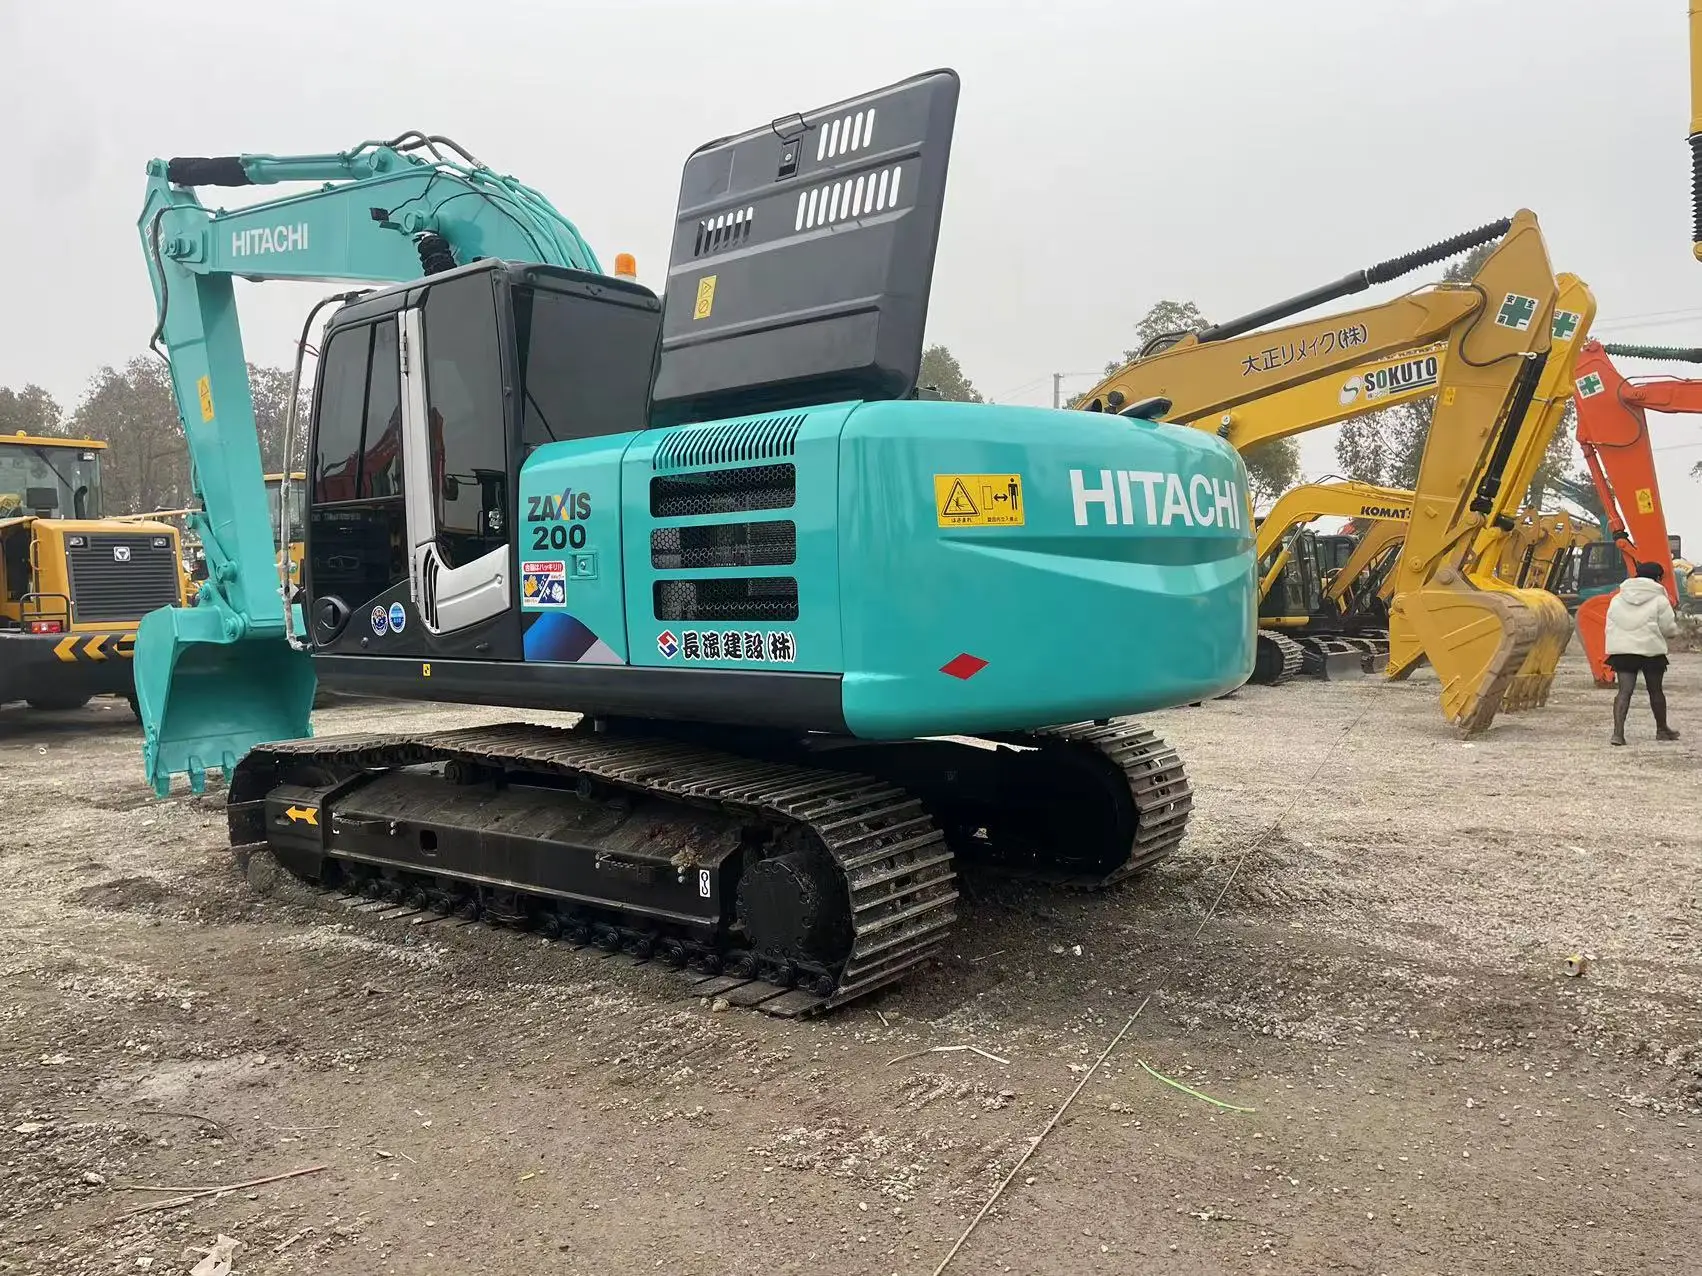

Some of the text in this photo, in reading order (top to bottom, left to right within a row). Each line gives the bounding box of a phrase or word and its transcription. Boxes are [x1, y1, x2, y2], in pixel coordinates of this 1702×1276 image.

[232, 222, 309, 257] HITACHI
[1241, 323, 1368, 377] 大正リメイク(株)
[1364, 356, 1438, 392] SOKUTO
[527, 487, 592, 522] ZAXIS
[1069, 469, 1241, 530] HITACHI
[1360, 505, 1411, 519] KOMAT
[532, 523, 587, 551] 200
